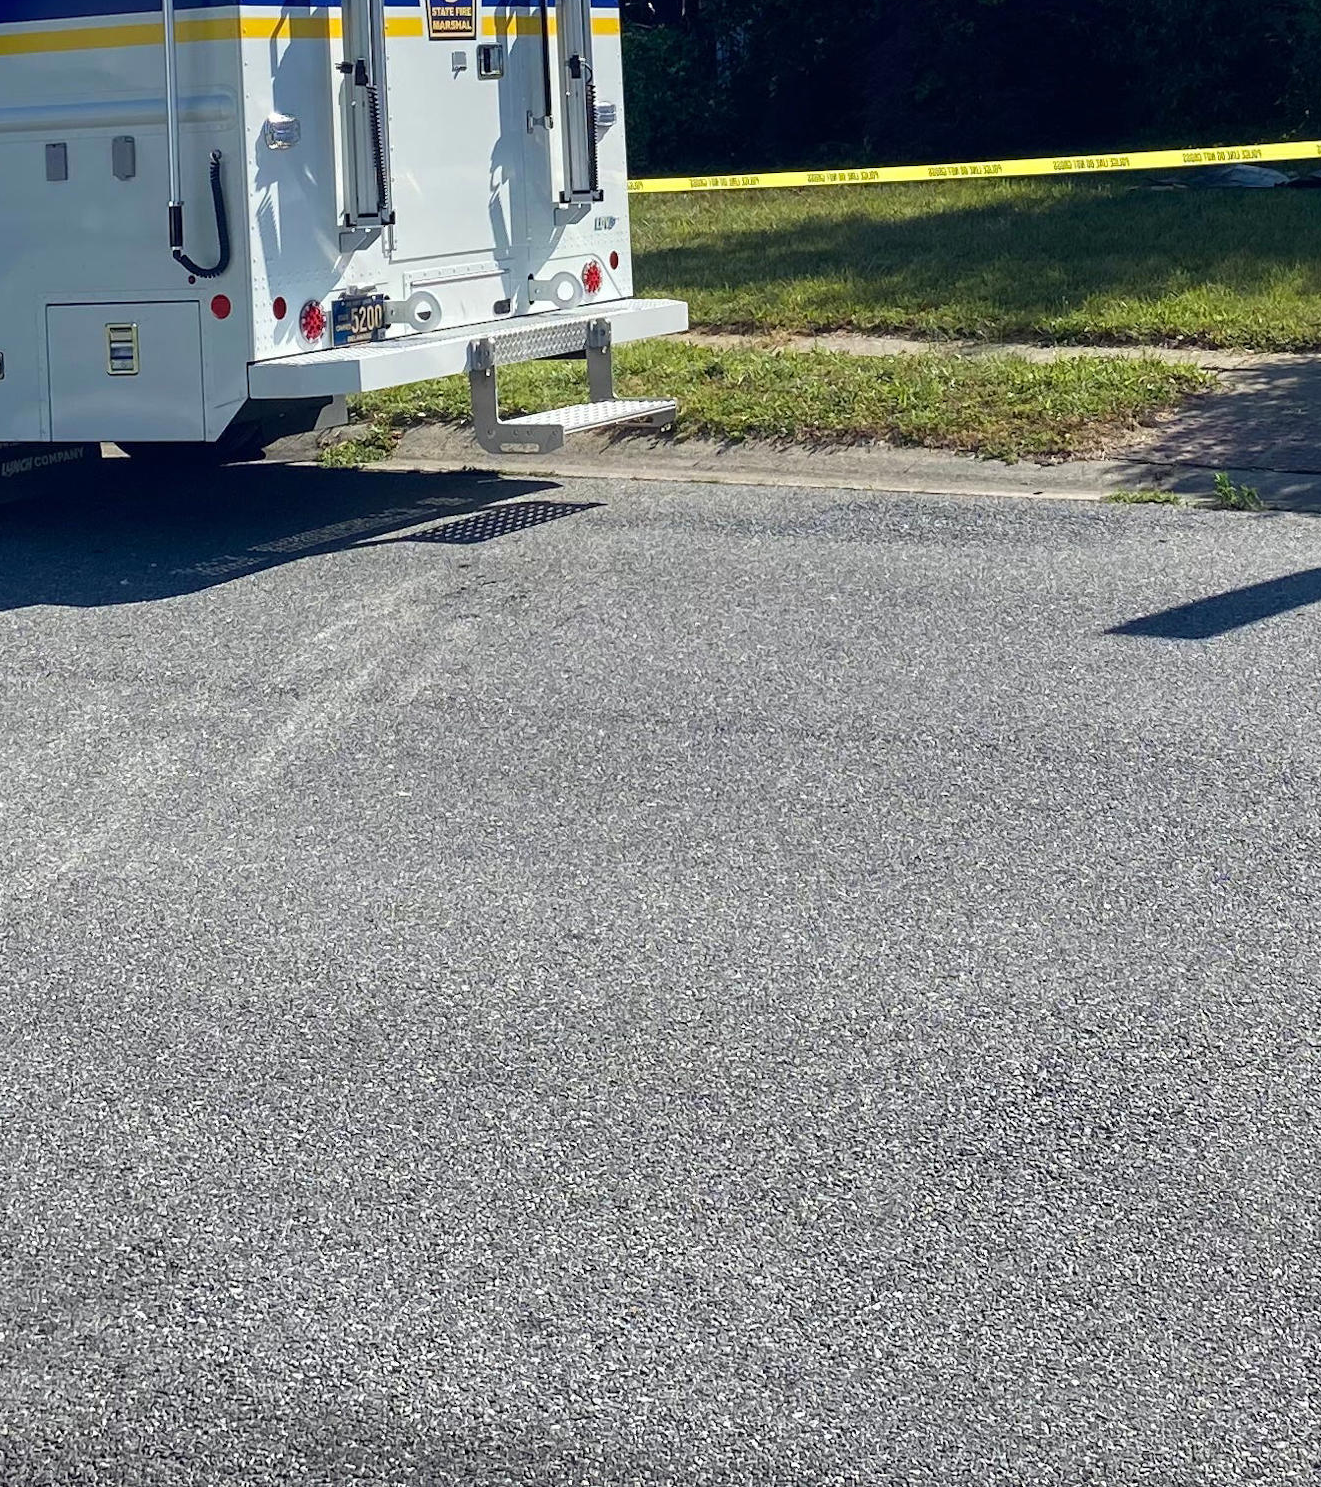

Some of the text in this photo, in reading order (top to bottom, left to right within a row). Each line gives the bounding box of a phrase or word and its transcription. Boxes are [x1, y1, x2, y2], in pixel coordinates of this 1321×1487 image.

[431, 6, 472, 16] STATE FIRE
[432, 20, 472, 30] MARSHAL
[351, 304, 382, 333] 5200
[0, 457, 34, 478] LYNCH
[34, 447, 85, 467] COMPANY
